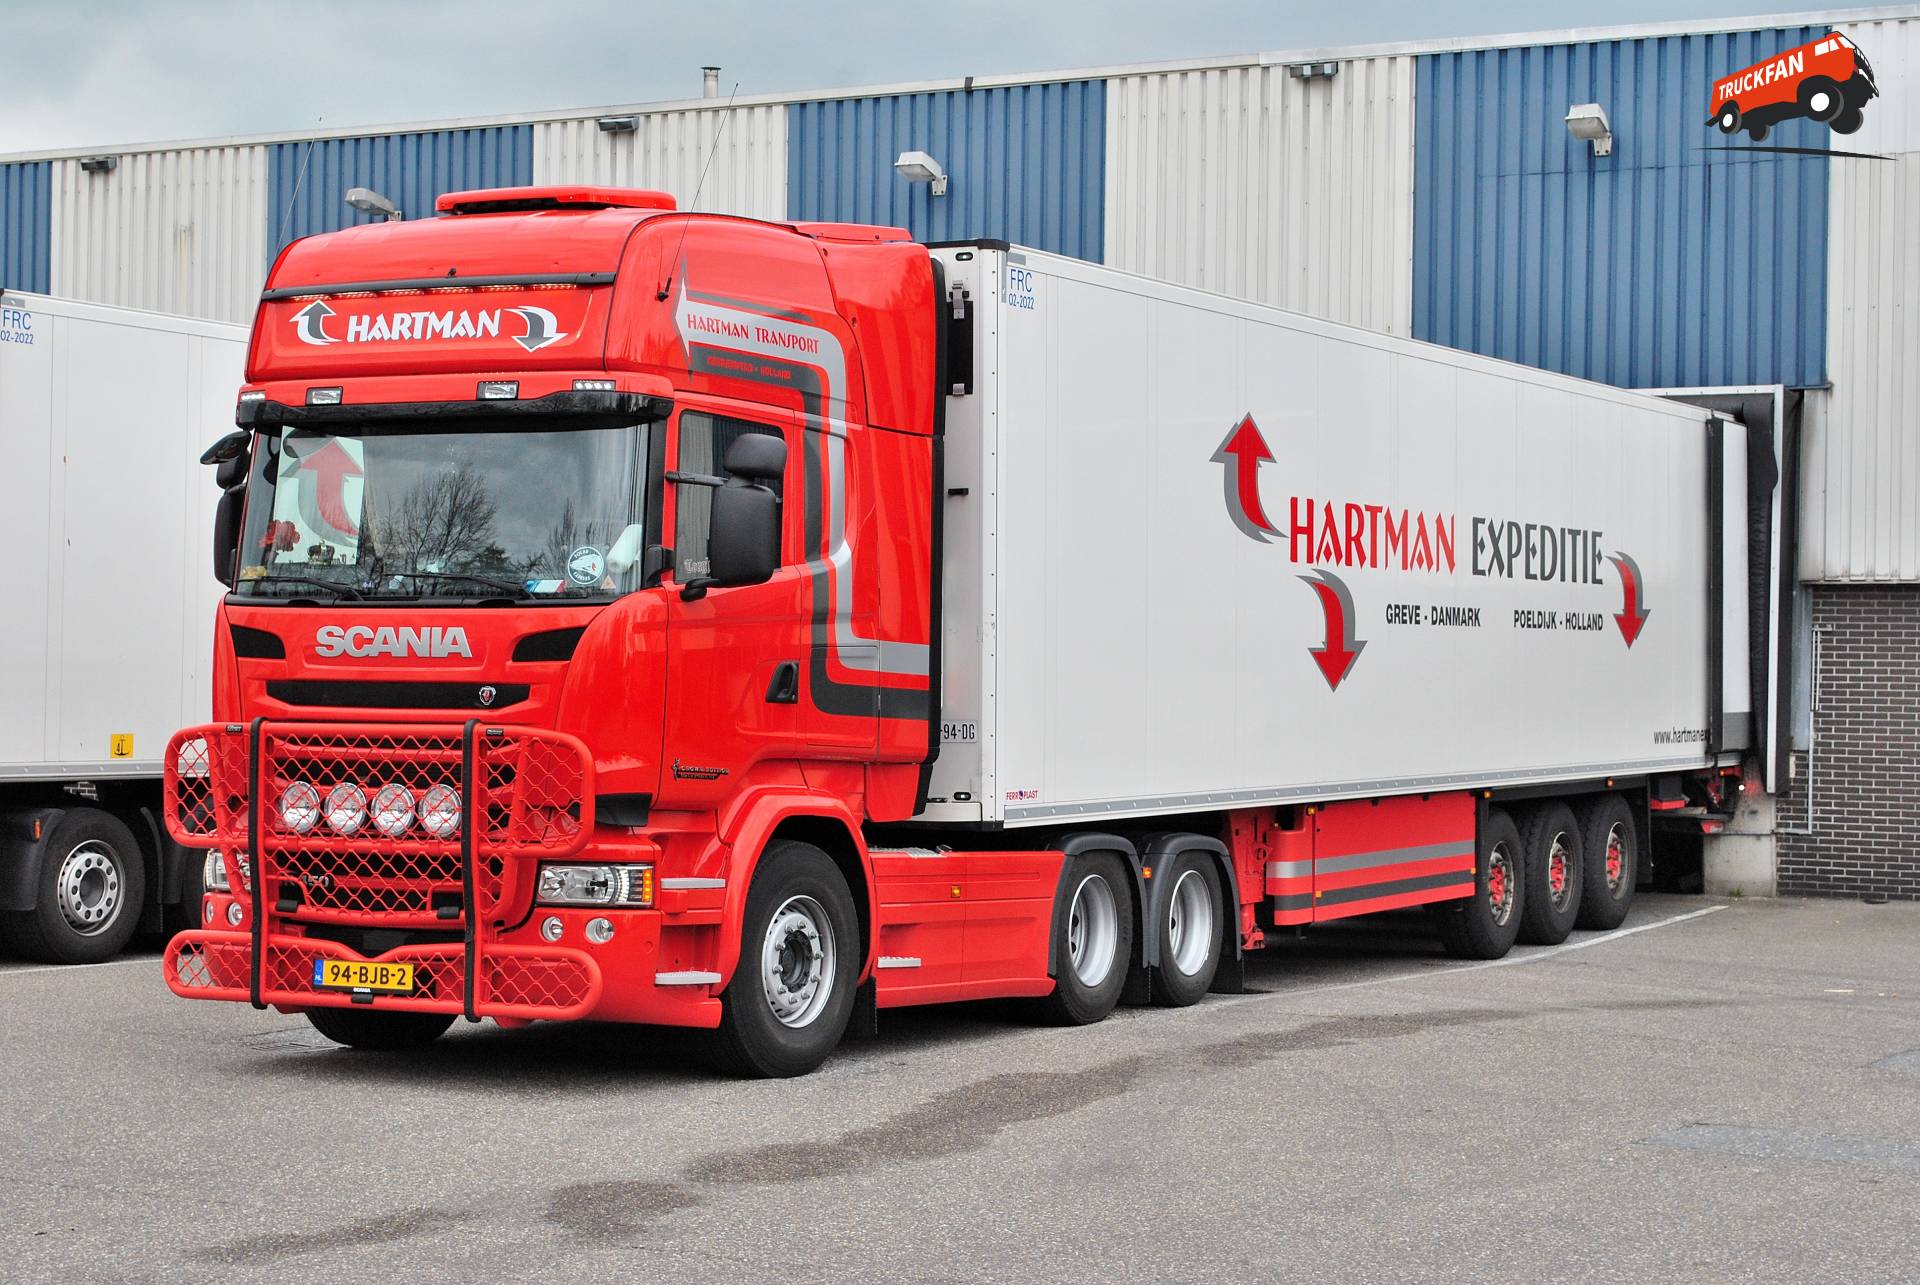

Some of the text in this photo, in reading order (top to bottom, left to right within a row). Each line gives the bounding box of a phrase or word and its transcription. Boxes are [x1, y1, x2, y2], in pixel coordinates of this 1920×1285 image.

[1010, 268, 1033, 293] FRC
[1008, 292, 1035, 310] 02-2022
[3, 309, 32, 330] FRC
[346, 308, 501, 343] HARTMAN
[0, 330, 34, 345] 02-2022
[687, 313, 819, 355] HARTMAN TRANSPORT
[1289, 497, 1604, 585] HARTMAN EXPEDITIE
[1385, 603, 1422, 626] GREVE
[1431, 606, 1482, 628] DANMARK
[1513, 609, 1558, 630] POELDIJK
[1565, 612, 1604, 632] HOLLAND
[315, 625, 474, 659] SCANIA
[1653, 727, 1712, 744] www.hartmanex
[330, 964, 407, 986] 94-BJB-2
